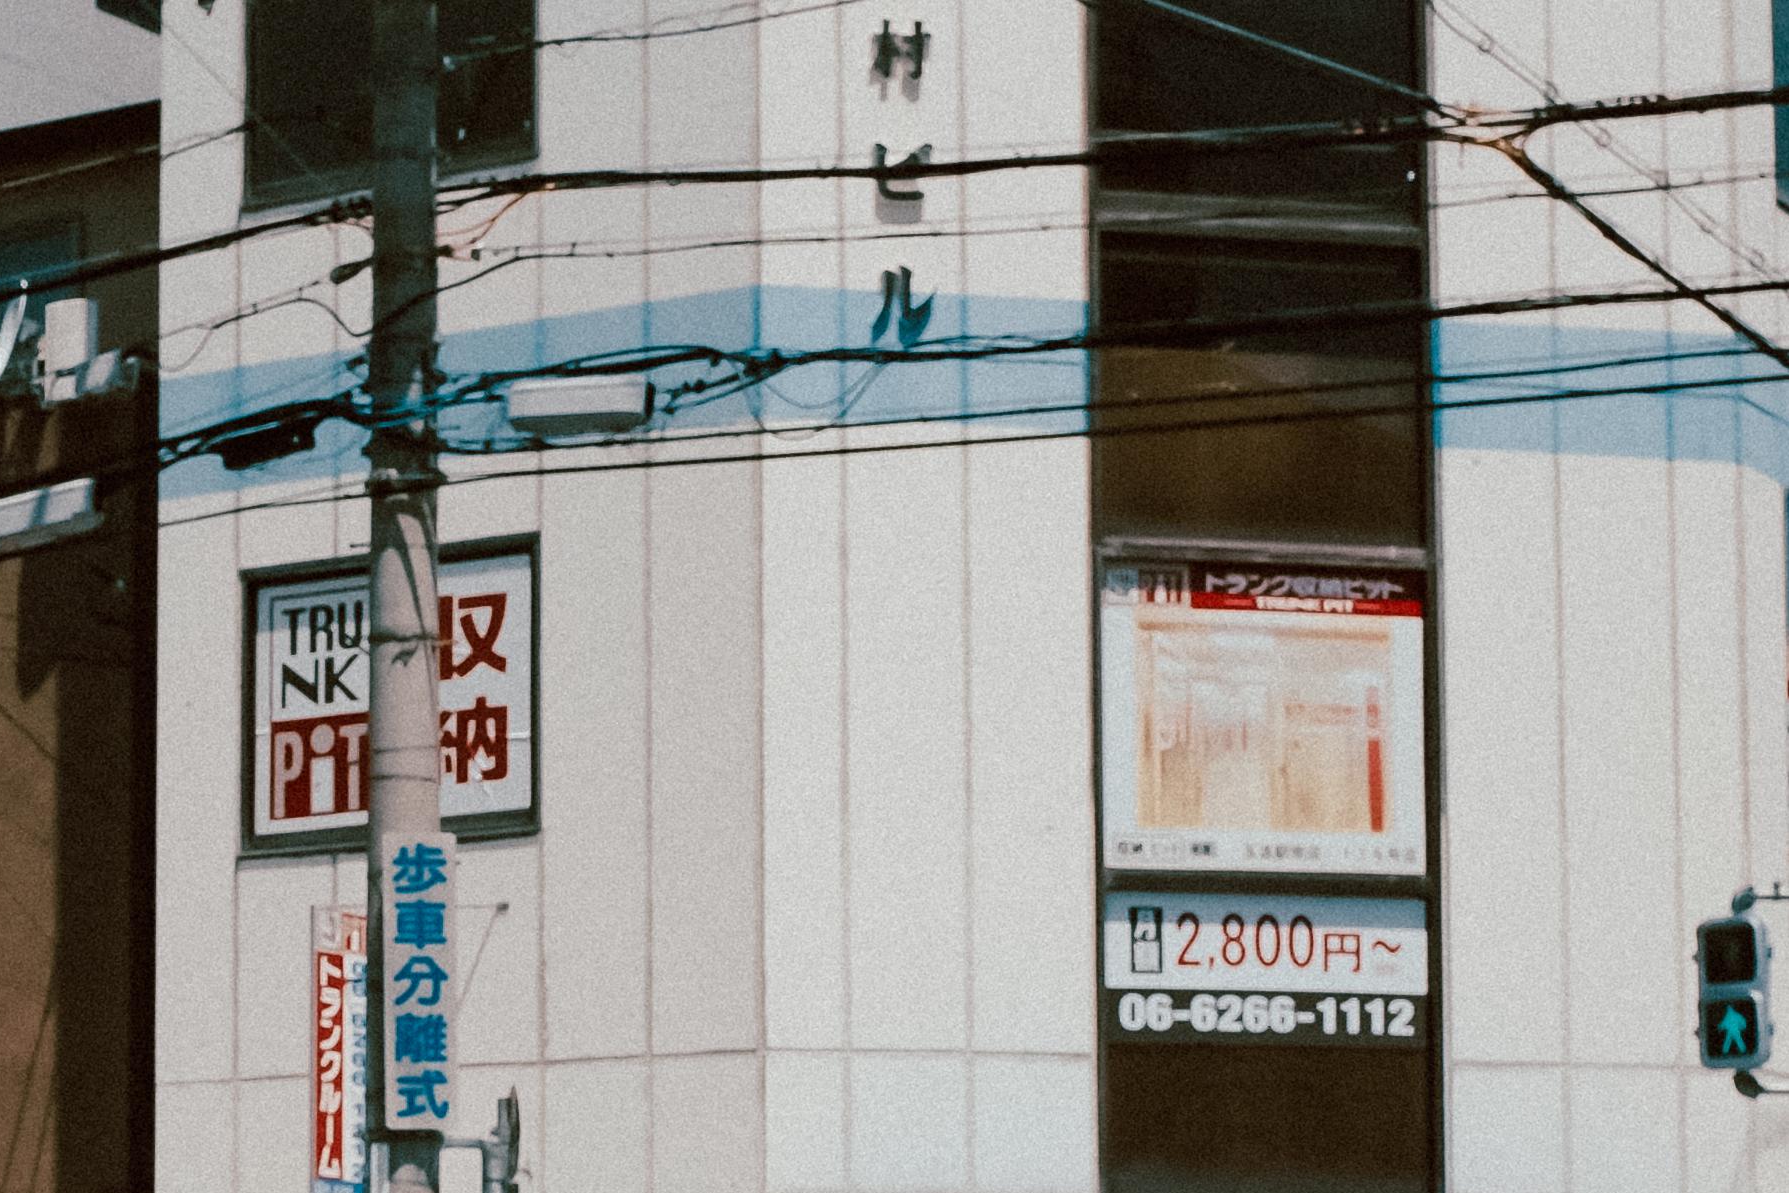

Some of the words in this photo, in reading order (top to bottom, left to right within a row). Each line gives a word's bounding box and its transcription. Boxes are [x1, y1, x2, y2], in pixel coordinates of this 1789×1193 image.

[281, 600, 364, 655] TRU
[281, 653, 358, 708] NK
[391, 842, 450, 1120] 歩車分離式
[1118, 992, 1416, 1037] 06-6266-1112
